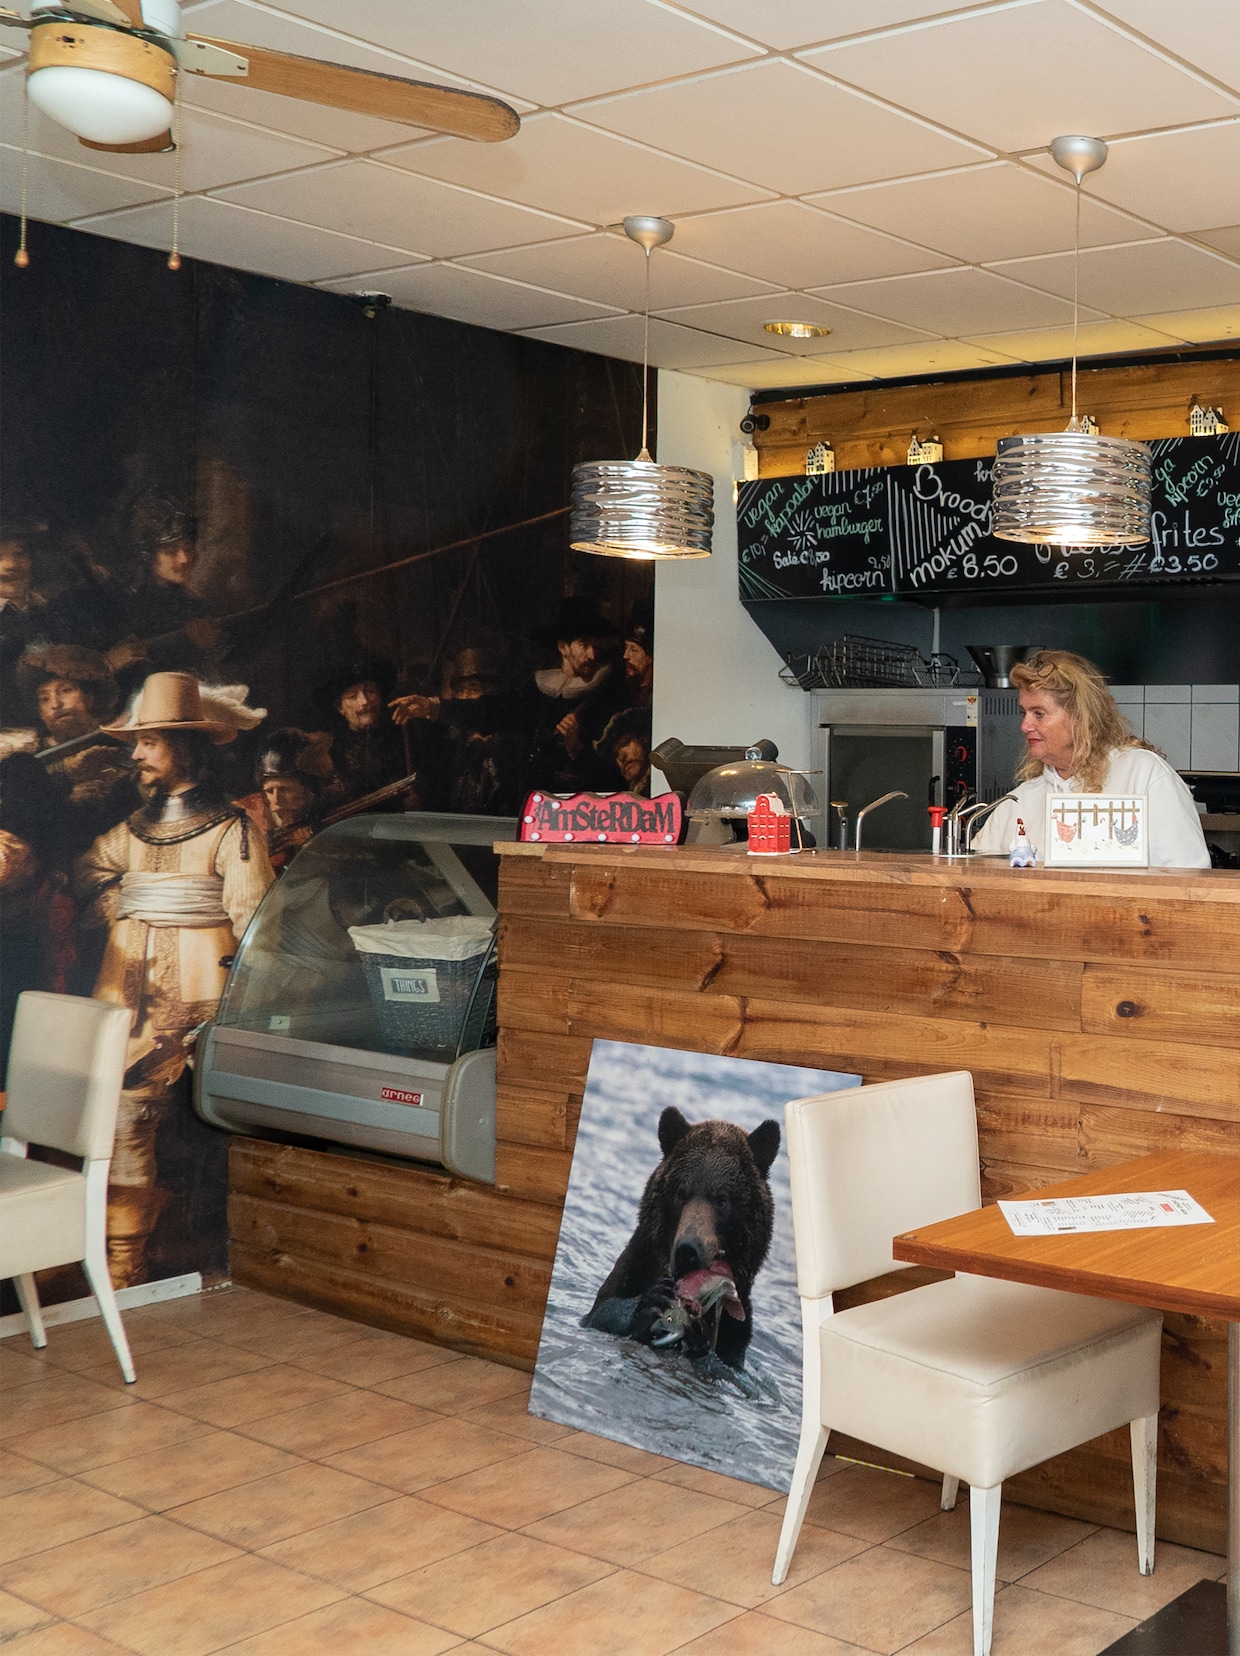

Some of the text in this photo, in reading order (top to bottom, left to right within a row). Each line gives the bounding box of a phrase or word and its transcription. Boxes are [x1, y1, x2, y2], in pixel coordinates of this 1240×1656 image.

[744, 483, 785, 528] vegan
[814, 502, 852, 526] vegan
[913, 464, 993, 537] Broodj
[816, 517, 884, 544] hamburger
[1151, 510, 1225, 563] frites
[910, 521, 984, 588] mokum
[820, 567, 886, 594] kipcorn
[395, 979, 426, 993] THINGS
